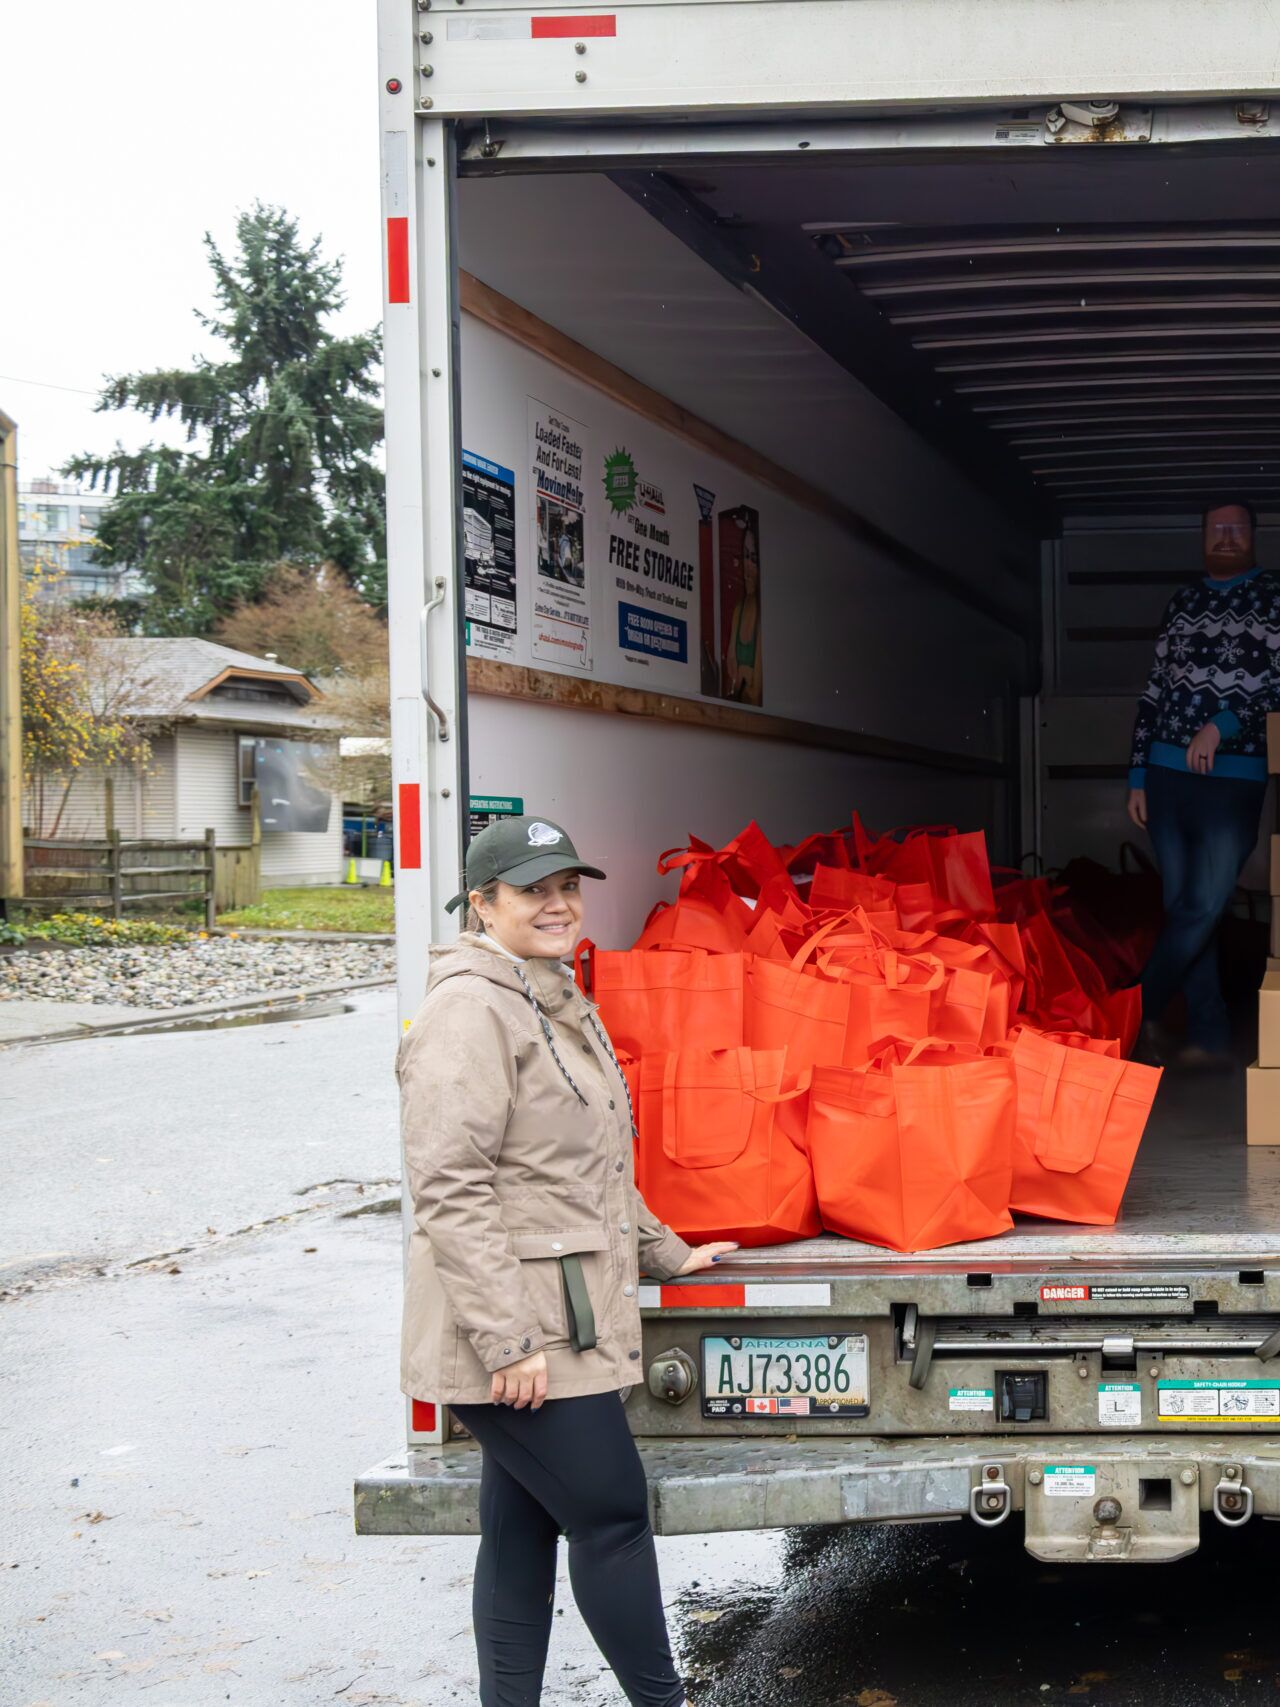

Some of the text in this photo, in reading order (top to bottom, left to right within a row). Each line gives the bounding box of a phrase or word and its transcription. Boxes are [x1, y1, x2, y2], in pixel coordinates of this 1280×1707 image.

[536, 422, 561, 450] Loaded
[537, 446, 551, 466] And
[552, 452, 564, 472] For
[635, 518, 647, 538] One
[649, 524, 669, 546] Month
[609, 534, 694, 592] FREE STORAGE
[1043, 1287, 1084, 1299] DANGER
[744, 1340, 827, 1349] ARIZONA
[718, 1353, 850, 1394] AJ73386
